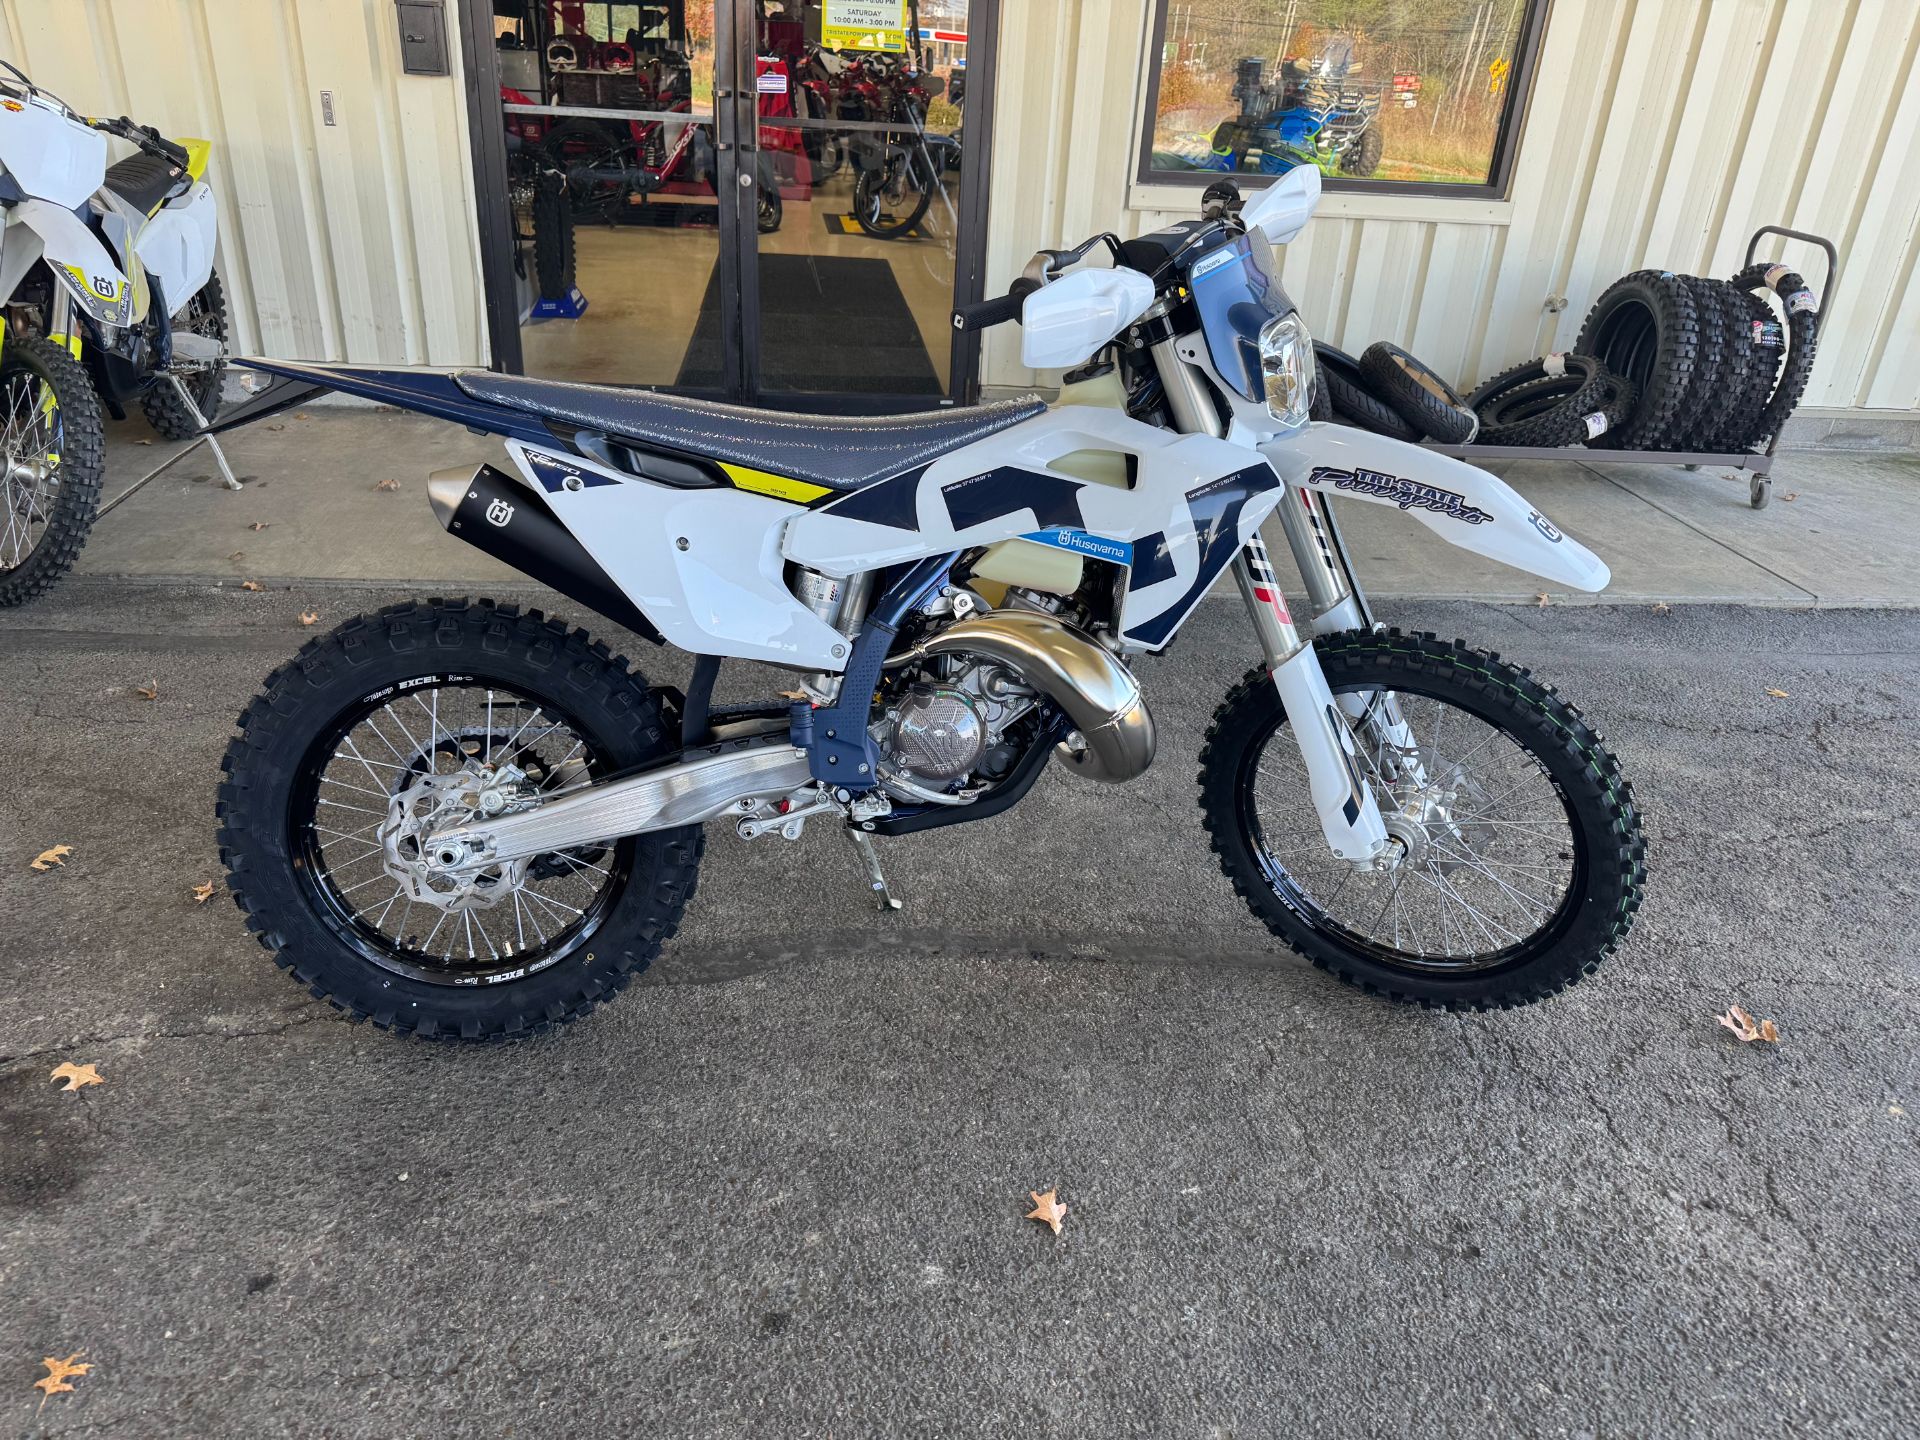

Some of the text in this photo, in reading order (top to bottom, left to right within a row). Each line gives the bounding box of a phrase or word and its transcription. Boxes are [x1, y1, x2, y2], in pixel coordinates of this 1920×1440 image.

[833, 16, 851, 24] 10:00
[869, 18, 883, 26] 3:00
[847, 8, 882, 16] SATURDAY
[1309, 466, 1495, 525] Powersports
[1356, 469, 1463, 509] TRI-STATE
[1070, 535, 1125, 558] Husqvarna
[398, 675, 441, 690] EXCEL
[1271, 885, 1295, 911] EXCEL
[484, 968, 525, 984] EXCEL
